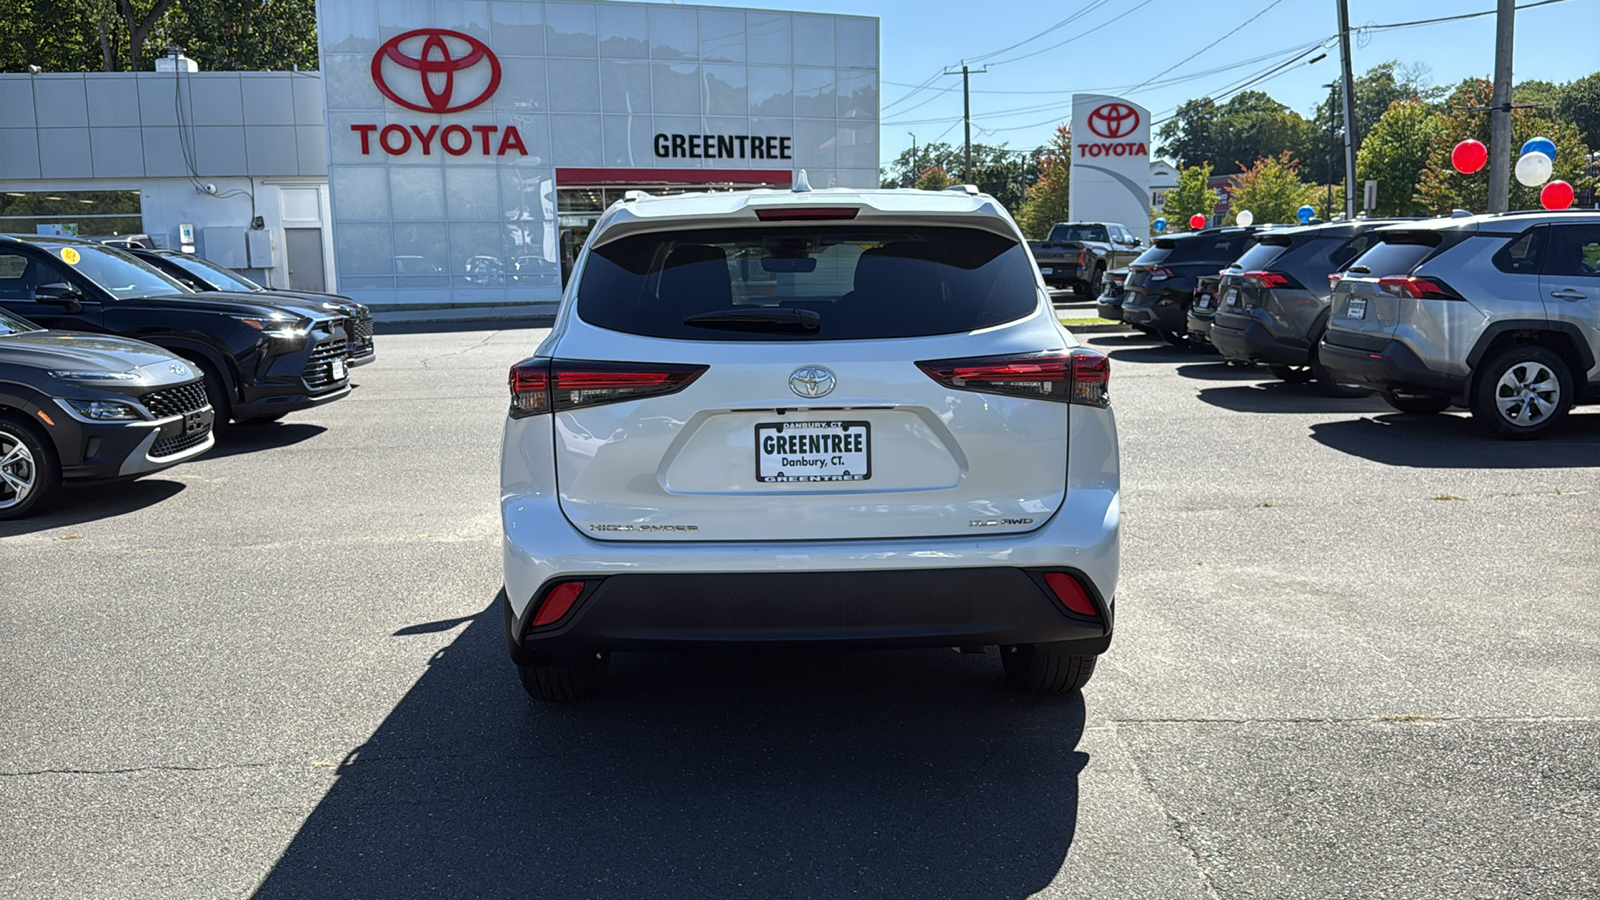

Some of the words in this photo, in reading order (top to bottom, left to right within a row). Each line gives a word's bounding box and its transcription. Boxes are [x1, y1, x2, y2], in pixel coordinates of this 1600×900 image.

[350, 124, 529, 156] TOYOTA
[654, 133, 792, 160] GREENTREE
[1077, 142, 1148, 158] TOYOTA
[763, 433, 863, 455] GREENTREE
[781, 456, 828, 469] Danbury,
[830, 456, 845, 466] CT.
[764, 474, 864, 482] GREENTREE
[590, 524, 699, 532] HIGHLANDER
